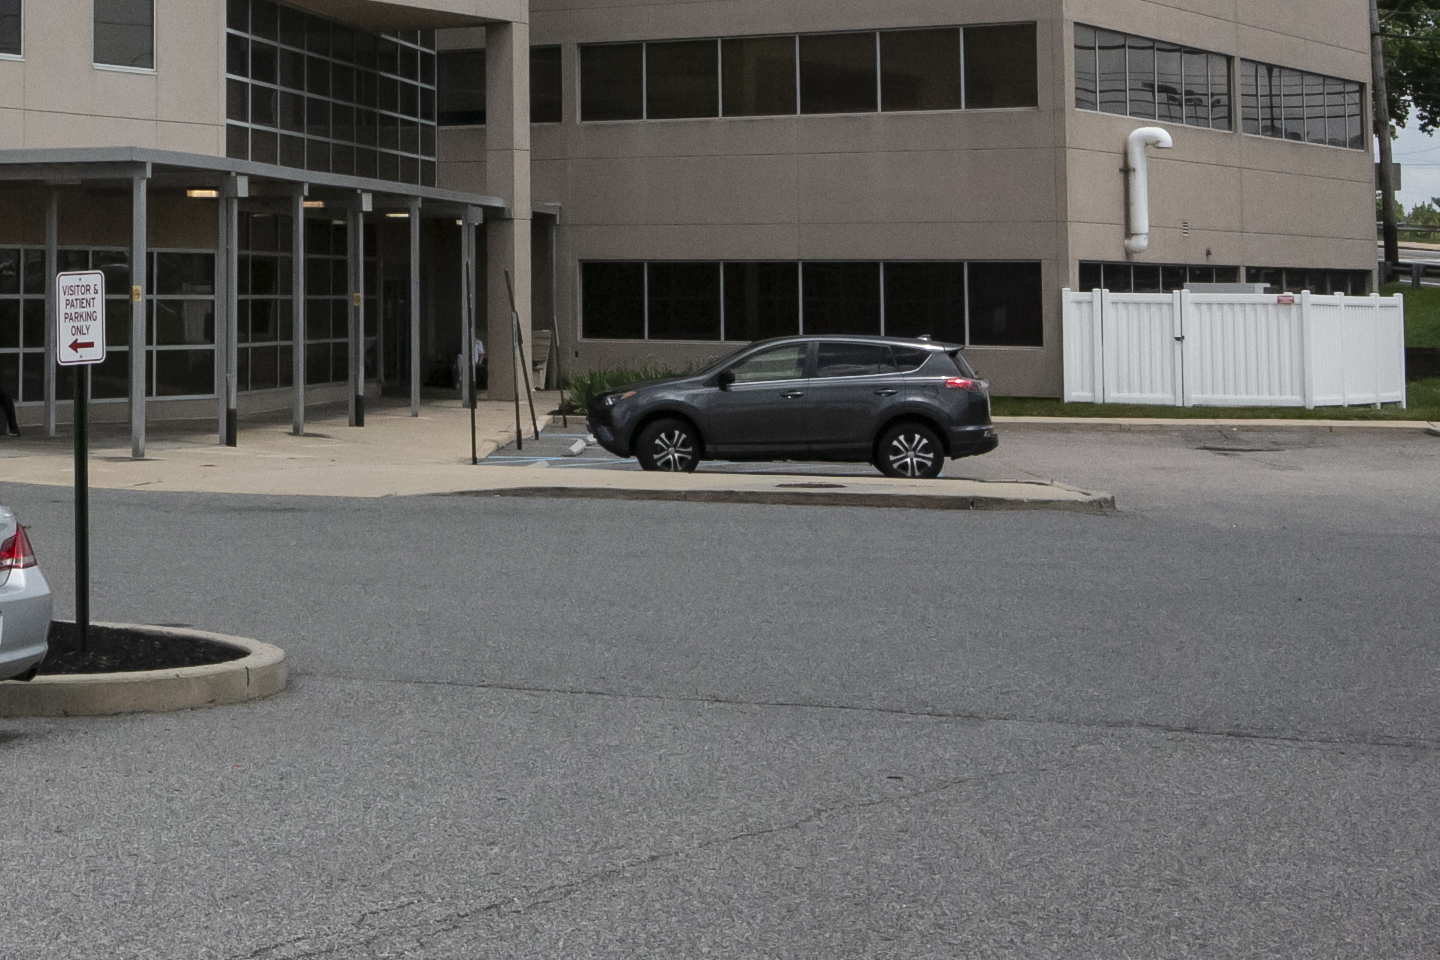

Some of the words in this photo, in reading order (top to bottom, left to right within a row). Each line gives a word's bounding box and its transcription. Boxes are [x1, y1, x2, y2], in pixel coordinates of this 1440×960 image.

[62, 284, 91, 296] VISITOR
[93, 283, 99, 295] &
[65, 297, 96, 309] PATIENT
[64, 311, 97, 323] PARKING
[70, 325, 91, 336] ONLY
